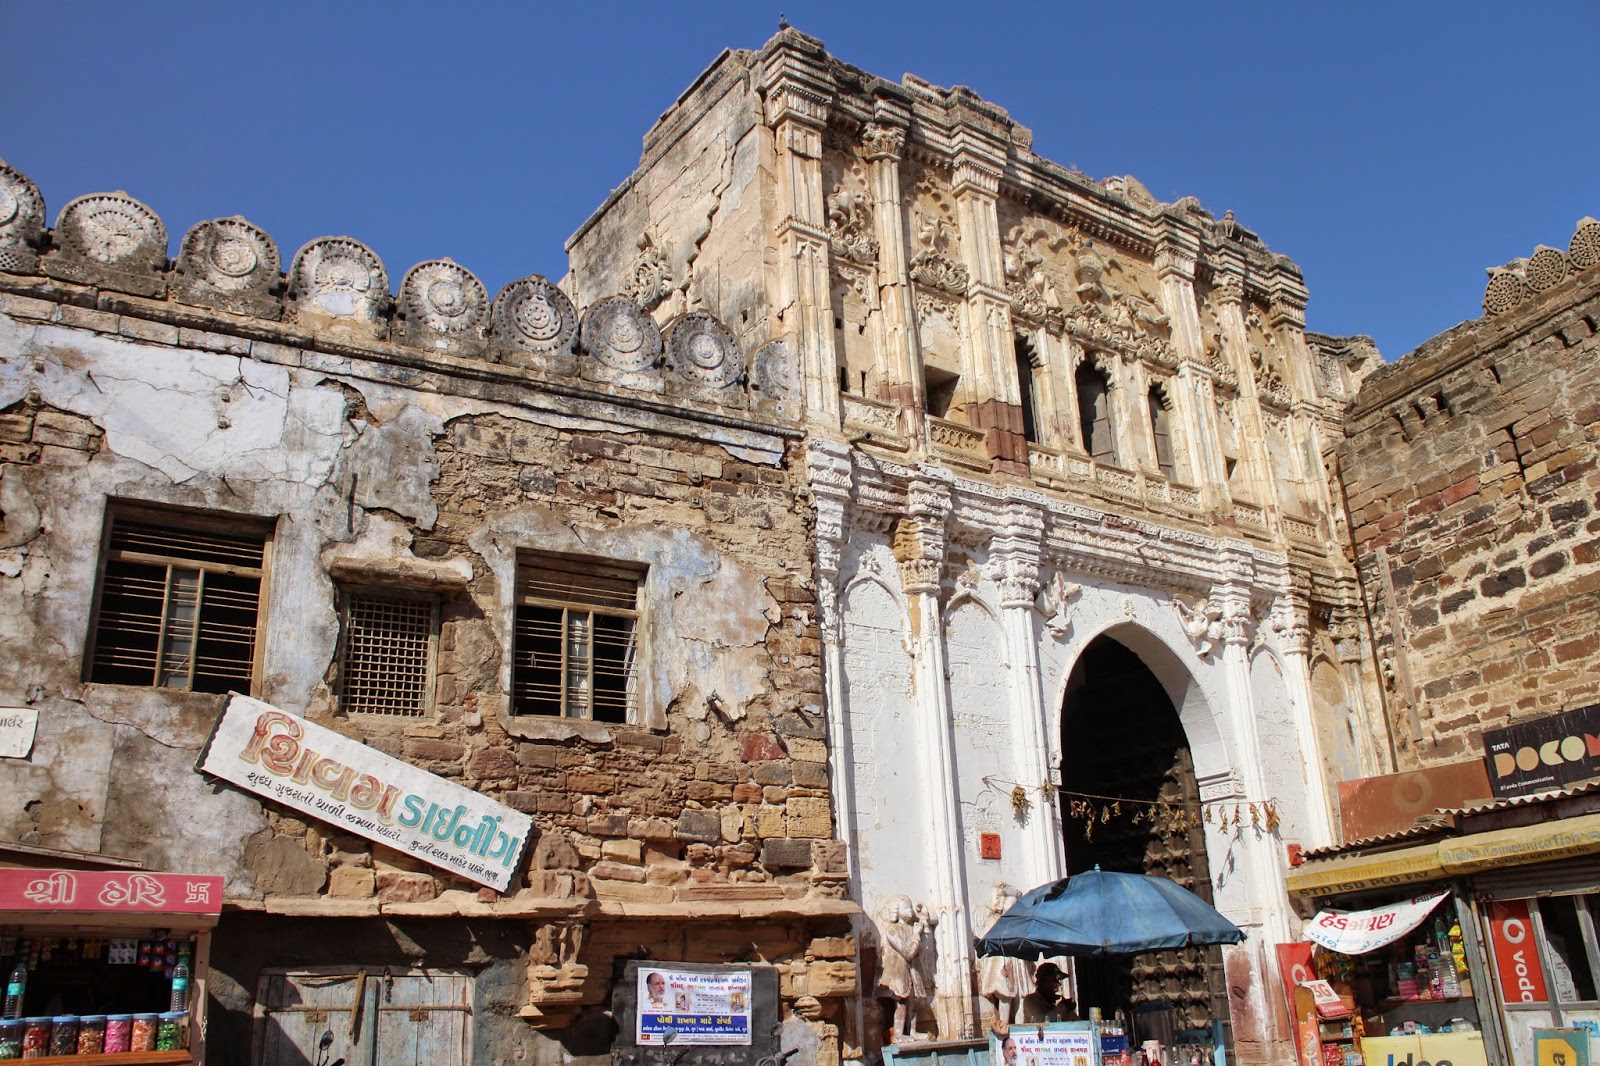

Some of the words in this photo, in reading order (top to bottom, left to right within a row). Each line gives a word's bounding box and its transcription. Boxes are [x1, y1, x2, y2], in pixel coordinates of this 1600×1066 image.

[0, 714, 23, 728] ાર્લર
[1491, 742, 1510, 752] TATA
[239, 711, 402, 827] શિવમ
[398, 794, 521, 868] ડાઈનીંગ
[1518, 775, 1555, 787] Communication
[275, 783, 315, 806] ગુજરાતી
[315, 798, 345, 818] થાળી
[24, 871, 76, 904] શ્રી
[99, 874, 166, 906] હરિ
[1299, 886, 1331, 898] STD
[1338, 881, 1366, 892] ISD
[1369, 876, 1400, 887] PCO
[1404, 871, 1431, 880] FAX
[1309, 983, 1332, 998] 3G
